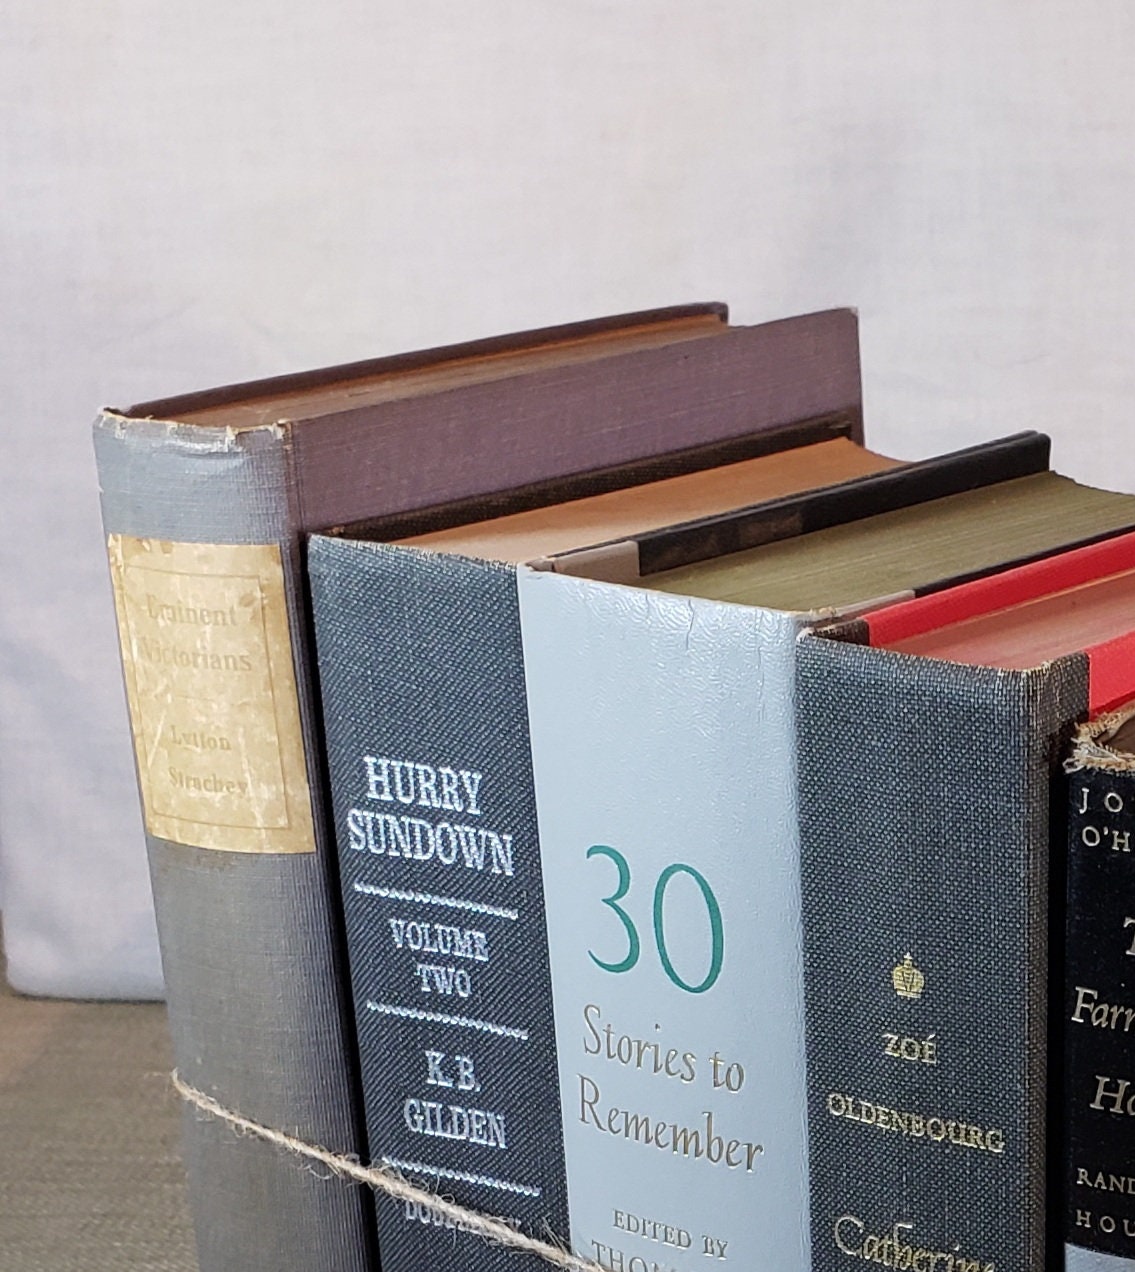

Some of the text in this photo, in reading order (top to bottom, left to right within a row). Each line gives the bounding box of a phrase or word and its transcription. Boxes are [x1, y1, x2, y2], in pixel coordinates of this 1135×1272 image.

[363, 755, 483, 815] HURRY
[347, 808, 515, 877] SUNDOWN
[388, 918, 489, 962] VOLUME
[586, 844, 725, 994] 30
[415, 962, 472, 998] TWO
[583, 1003, 745, 1093] Stories to
[404, 1099, 508, 1150] GILDEN
[576, 1073, 765, 1172] Remember
[827, 1093, 1005, 1153] OLDENBOURG
[612, 1208, 729, 1261] EDITED BY
